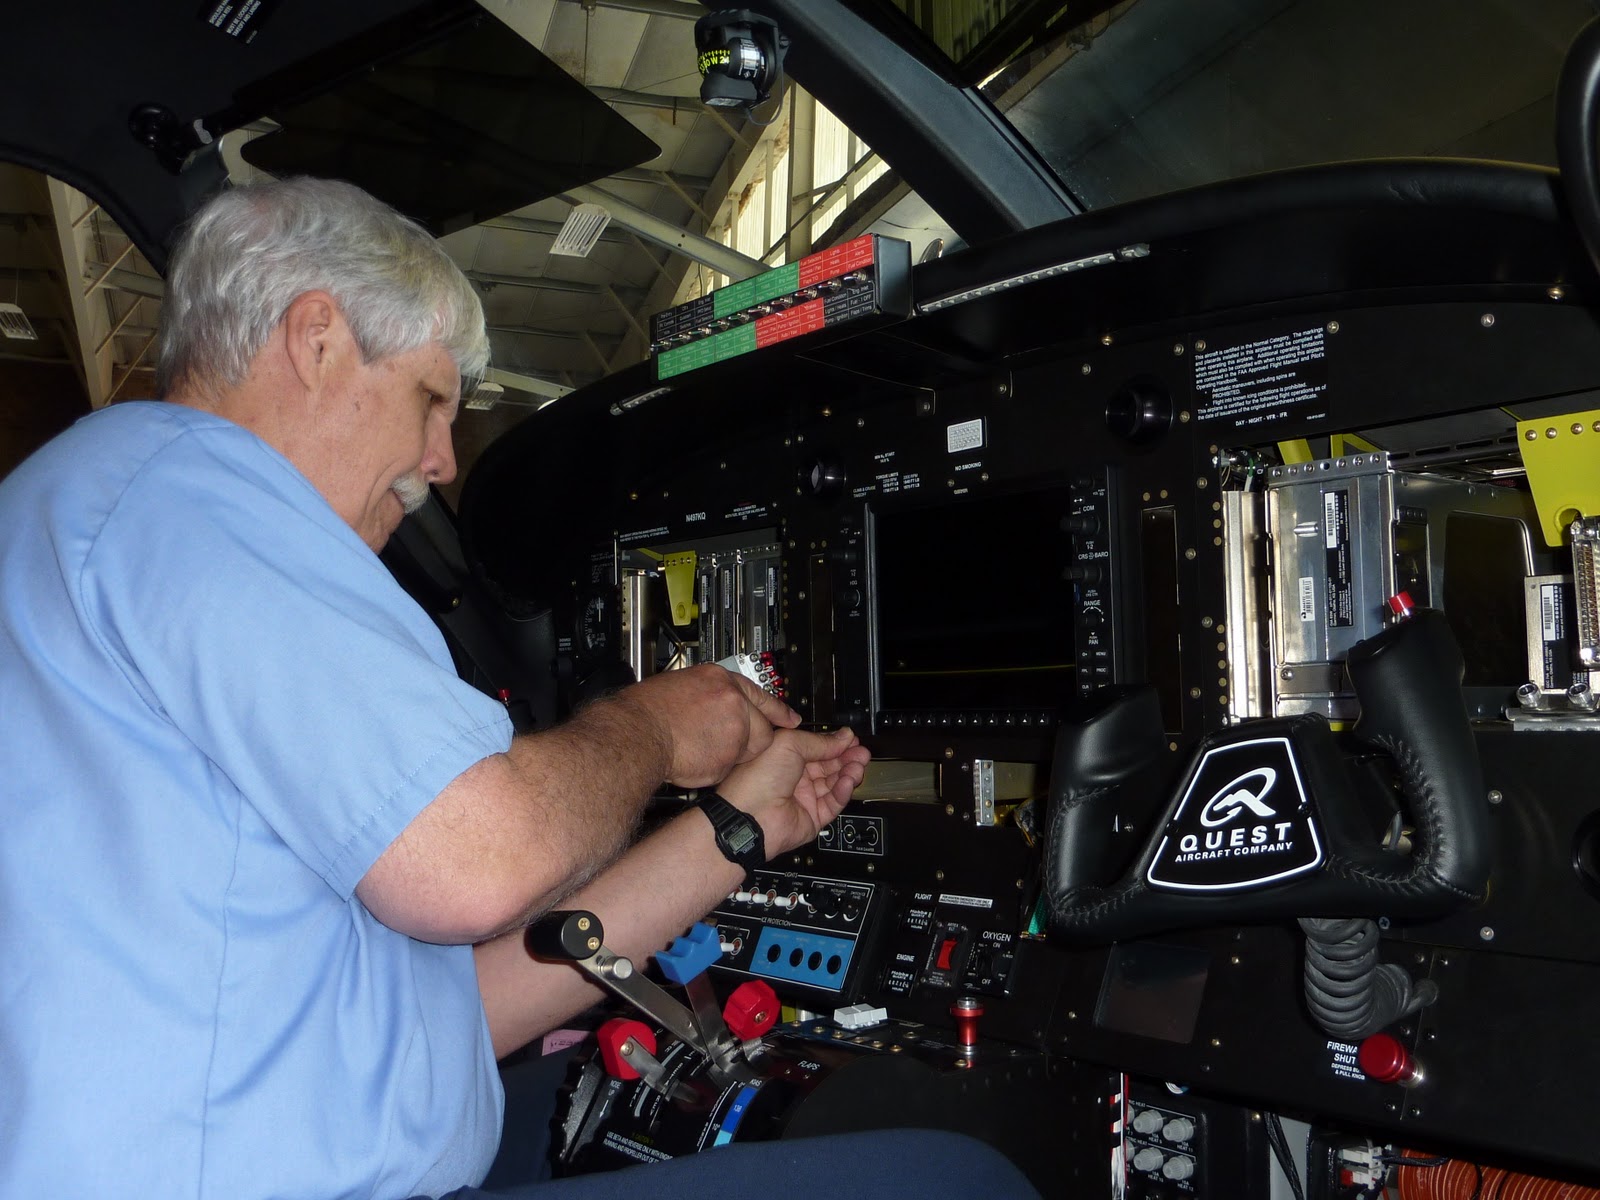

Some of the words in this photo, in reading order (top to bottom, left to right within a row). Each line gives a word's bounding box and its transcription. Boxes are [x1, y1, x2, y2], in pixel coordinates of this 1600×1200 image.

[962, 461, 981, 470] SMOKING
[686, 512, 706, 523] N497KQ
[1180, 822, 1292, 852] QUEST
[1175, 849, 1231, 863] AIRCRAFT
[1234, 841, 1293, 856] COMPANY
[914, 892, 932, 901] FLIGHT
[767, 918, 792, 927] PROTECTION
[982, 931, 1011, 942] OXYGEN
[896, 953, 915, 962] ENGINE
[1334, 1053, 1356, 1065] SHUT
[797, 1060, 821, 1071] FLAPS
[1331, 1063, 1352, 1071] DEPRESS
[750, 1078, 763, 1087] KIAS
[628, 1139, 643, 1151] REVERSE
[642, 1145, 651, 1154] ONLY
[624, 1147, 641, 1158] PROPELLER
